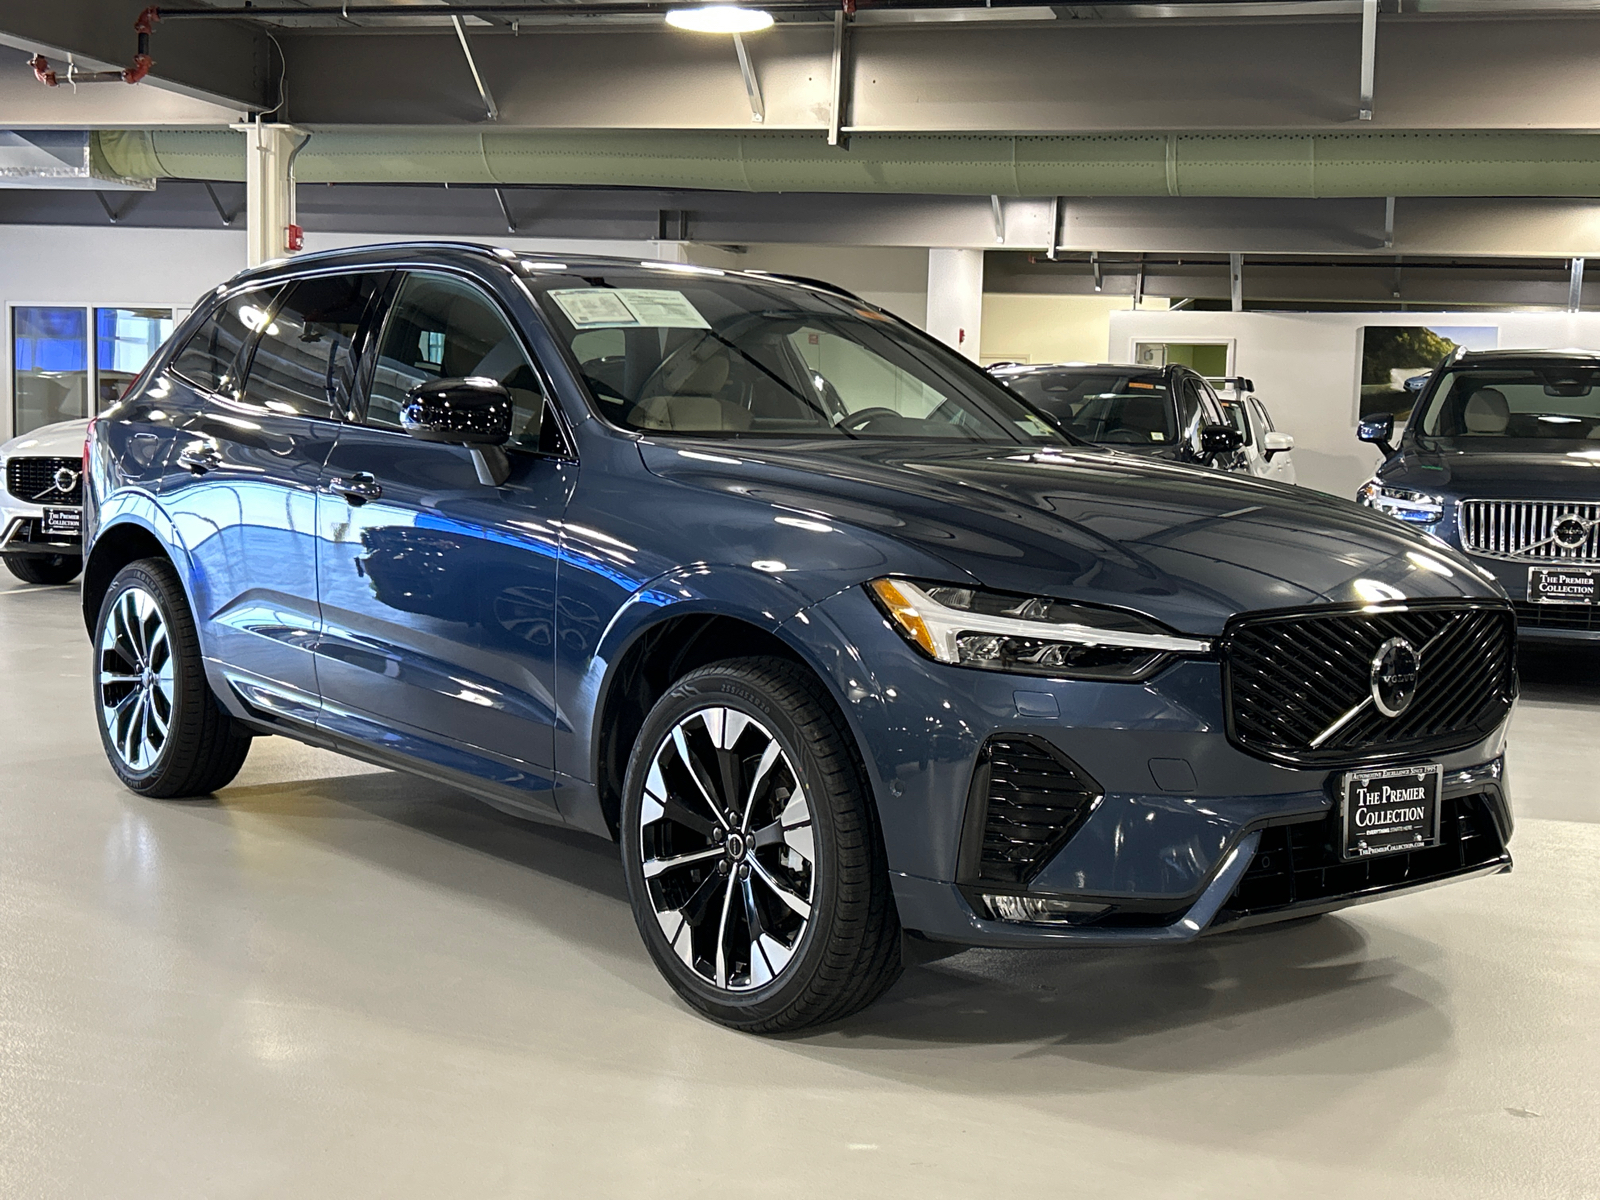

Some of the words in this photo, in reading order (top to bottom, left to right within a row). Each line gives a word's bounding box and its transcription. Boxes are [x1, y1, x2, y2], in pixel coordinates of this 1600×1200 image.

[60, 512, 80, 520] PREMIER
[1540, 574, 1558, 584] THE
[1559, 575, 1594, 585] PREMIER
[1539, 583, 1594, 594] COLLECTION
[1356, 788, 1380, 806] THE
[1382, 786, 1425, 803] PREMIER
[1355, 807, 1425, 827] COLLECTION
